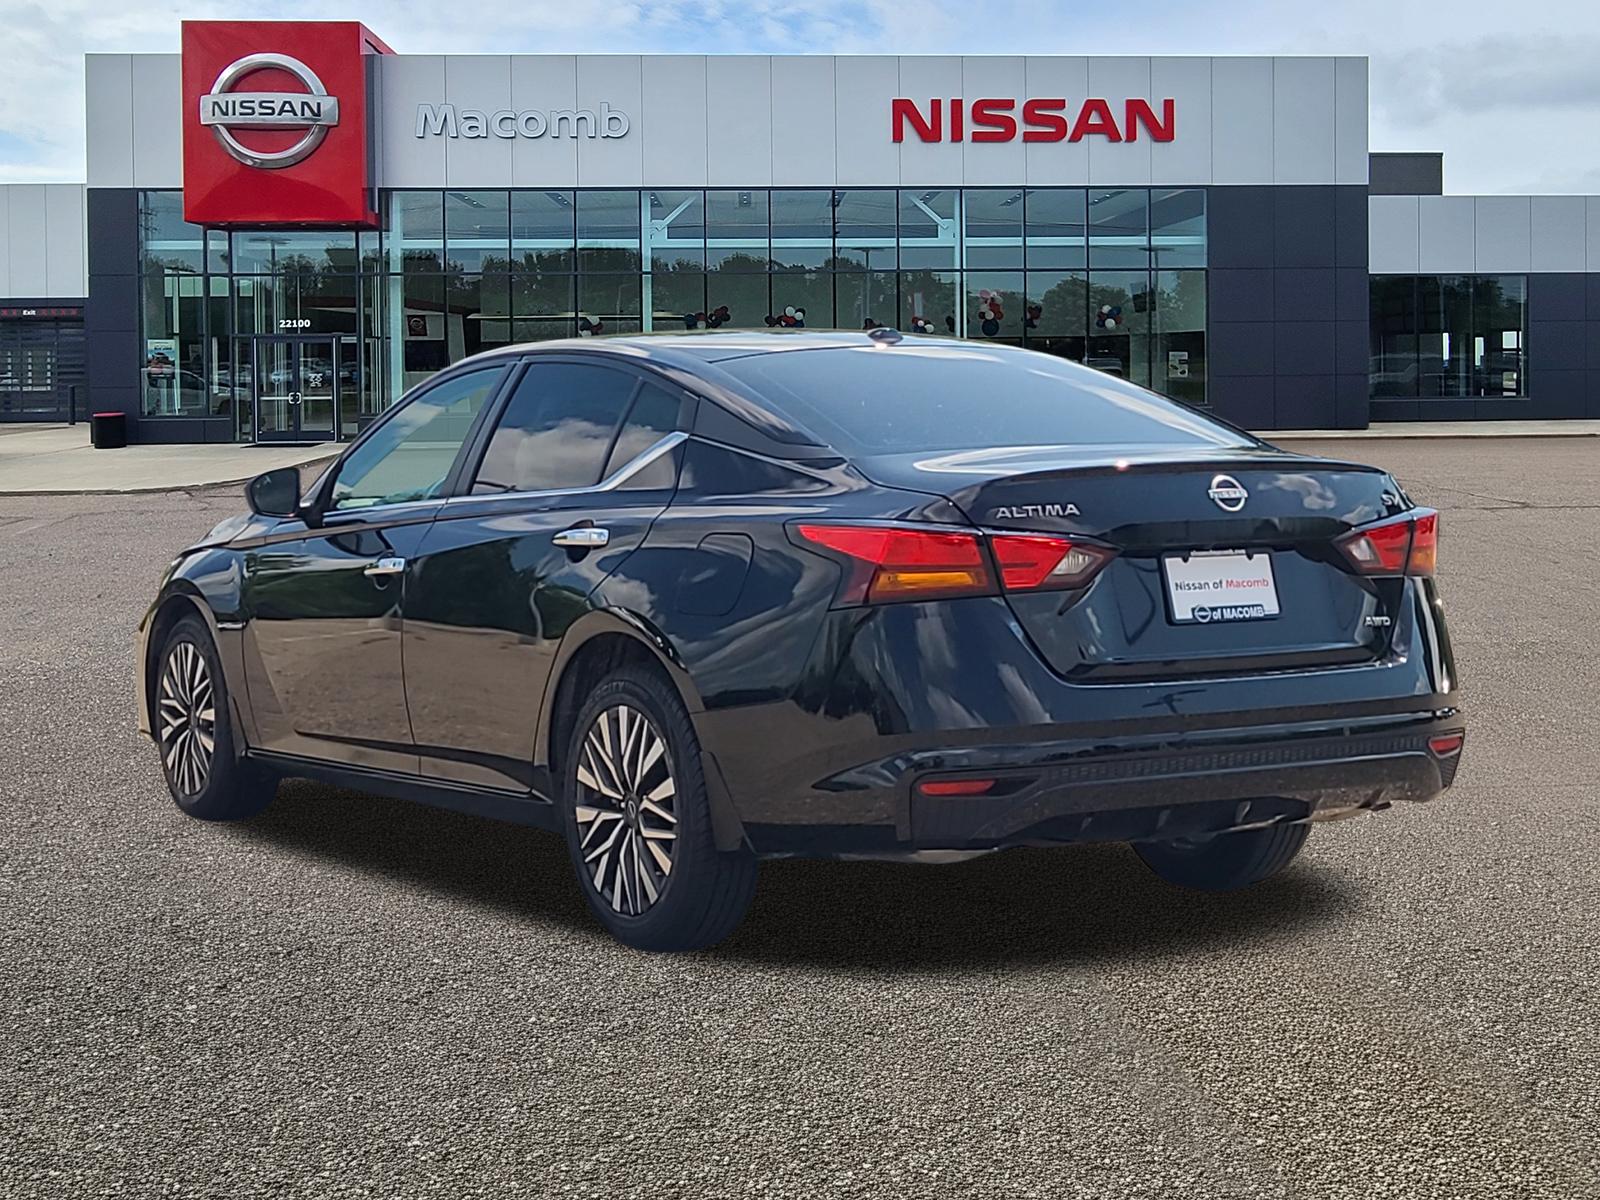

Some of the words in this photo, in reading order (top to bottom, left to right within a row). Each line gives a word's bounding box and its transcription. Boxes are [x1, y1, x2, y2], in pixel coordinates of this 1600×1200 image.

[212, 100, 322, 118] NISSAN
[415, 102, 630, 139] Macomb
[892, 98, 1175, 142] NISSAN
[279, 319, 311, 328] 22100
[995, 503, 1080, 519] ALTIMA
[1175, 580, 1210, 591] Nissan
[1212, 579, 1223, 590] of
[1226, 578, 1270, 589] Macomb
[1212, 609, 1222, 620] of
[1223, 606, 1265, 619] MACOMB
